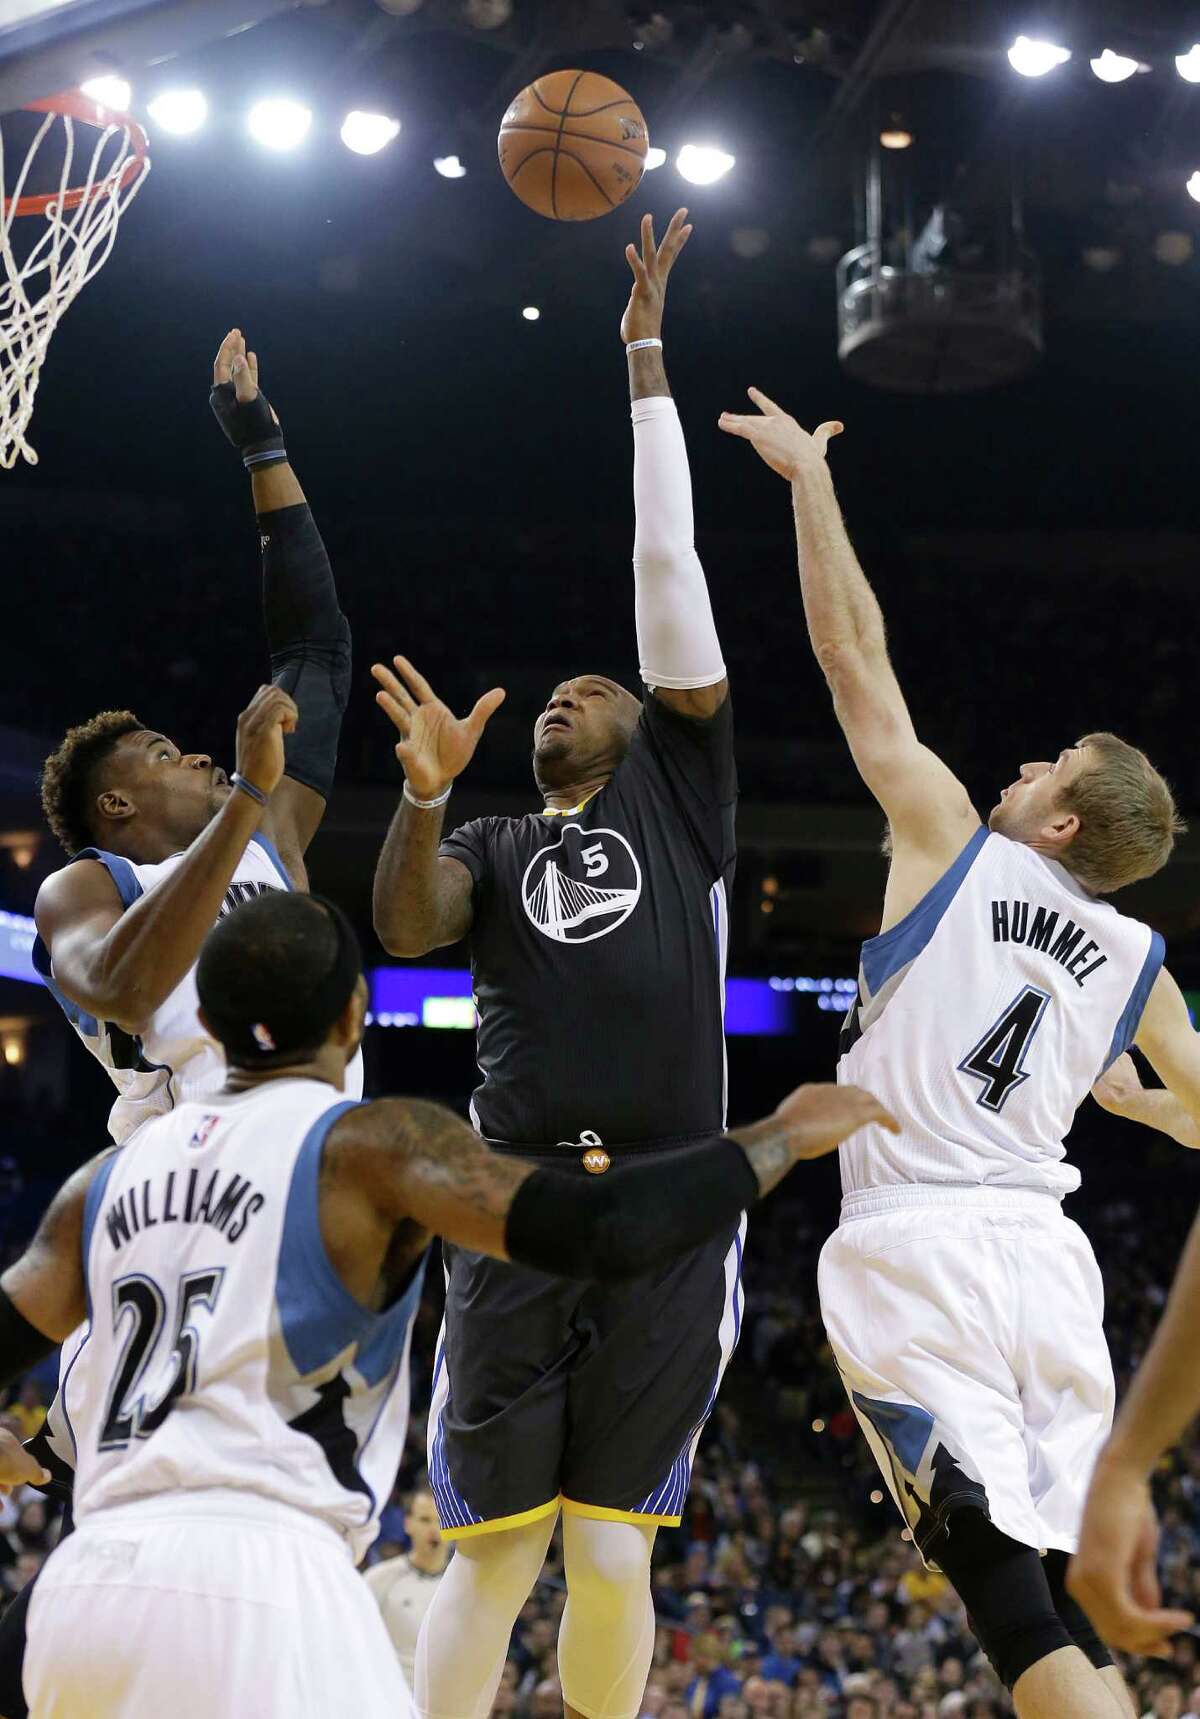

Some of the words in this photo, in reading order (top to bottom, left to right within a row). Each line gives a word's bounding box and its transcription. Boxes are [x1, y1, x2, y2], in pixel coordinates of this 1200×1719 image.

[580, 841, 609, 878] 5
[990, 900, 1108, 988] HUMMEL
[957, 983, 1051, 1114] 4
[105, 1168, 265, 1250] WILLIAMS
[97, 1266, 226, 1453] 25
